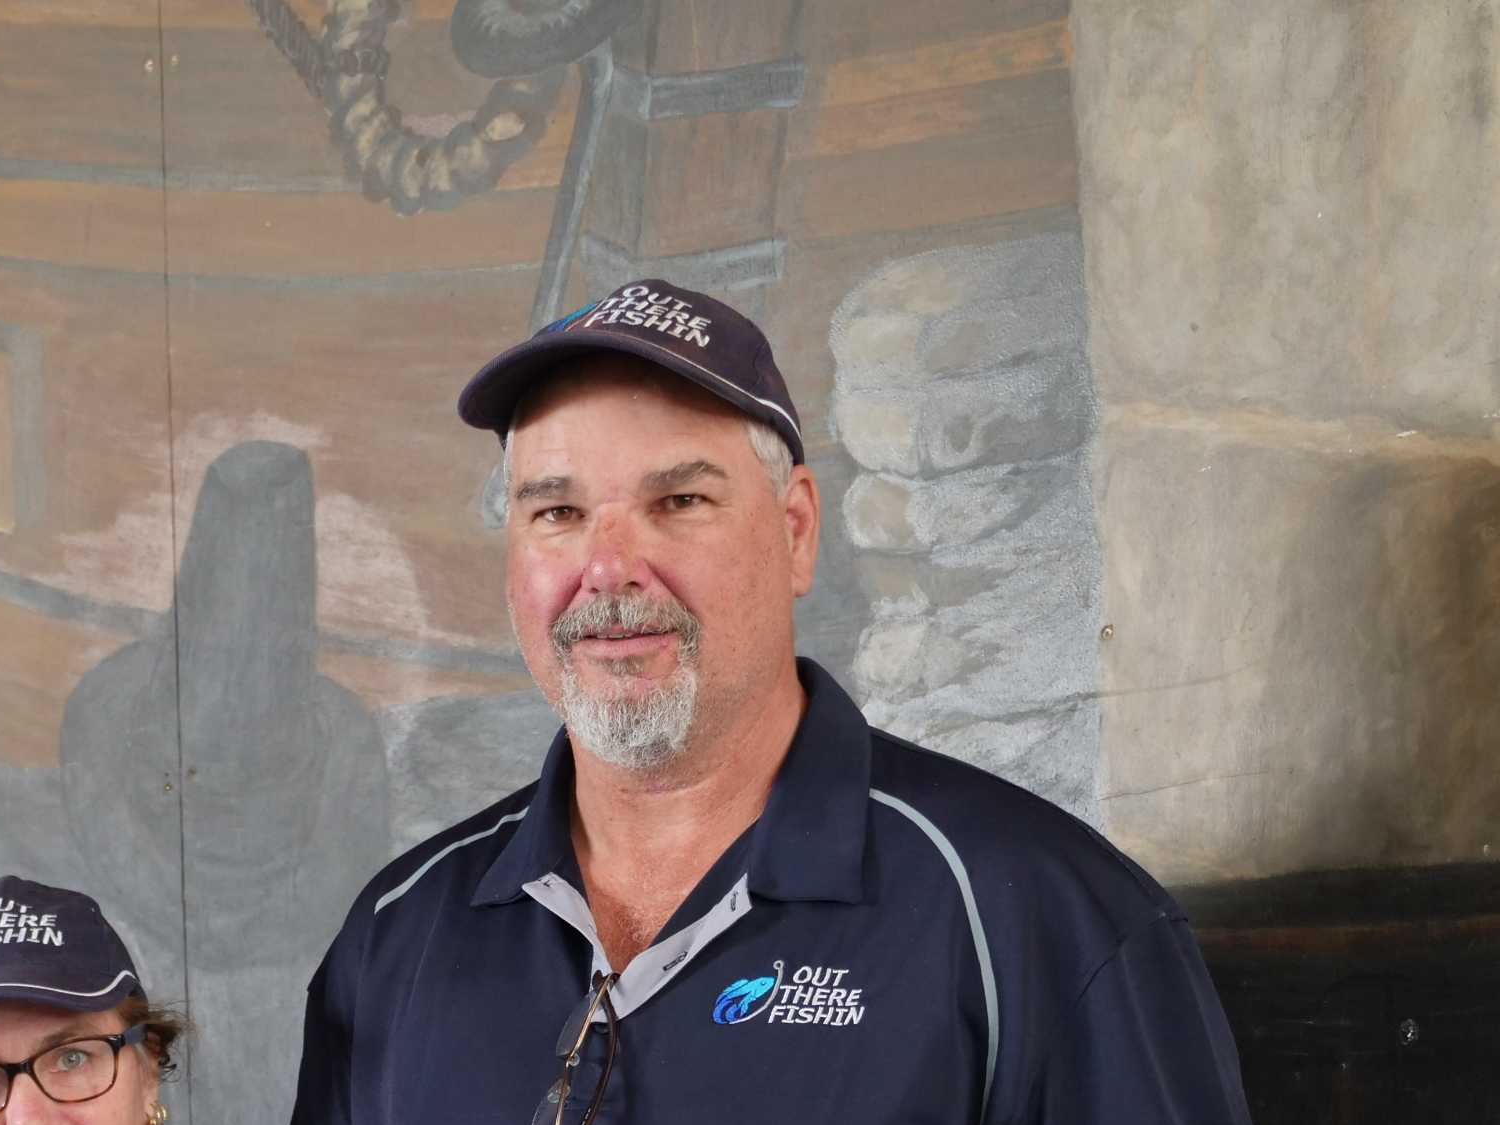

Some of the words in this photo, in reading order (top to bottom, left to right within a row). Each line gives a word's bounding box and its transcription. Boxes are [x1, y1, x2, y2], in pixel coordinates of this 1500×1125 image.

[622, 285, 692, 311] OUT
[605, 297, 712, 331] THERE
[584, 309, 711, 348] FISHIN
[792, 966, 850, 987] OUT
[779, 985, 863, 1006] THERE
[767, 1005, 866, 1026] FISHIN
